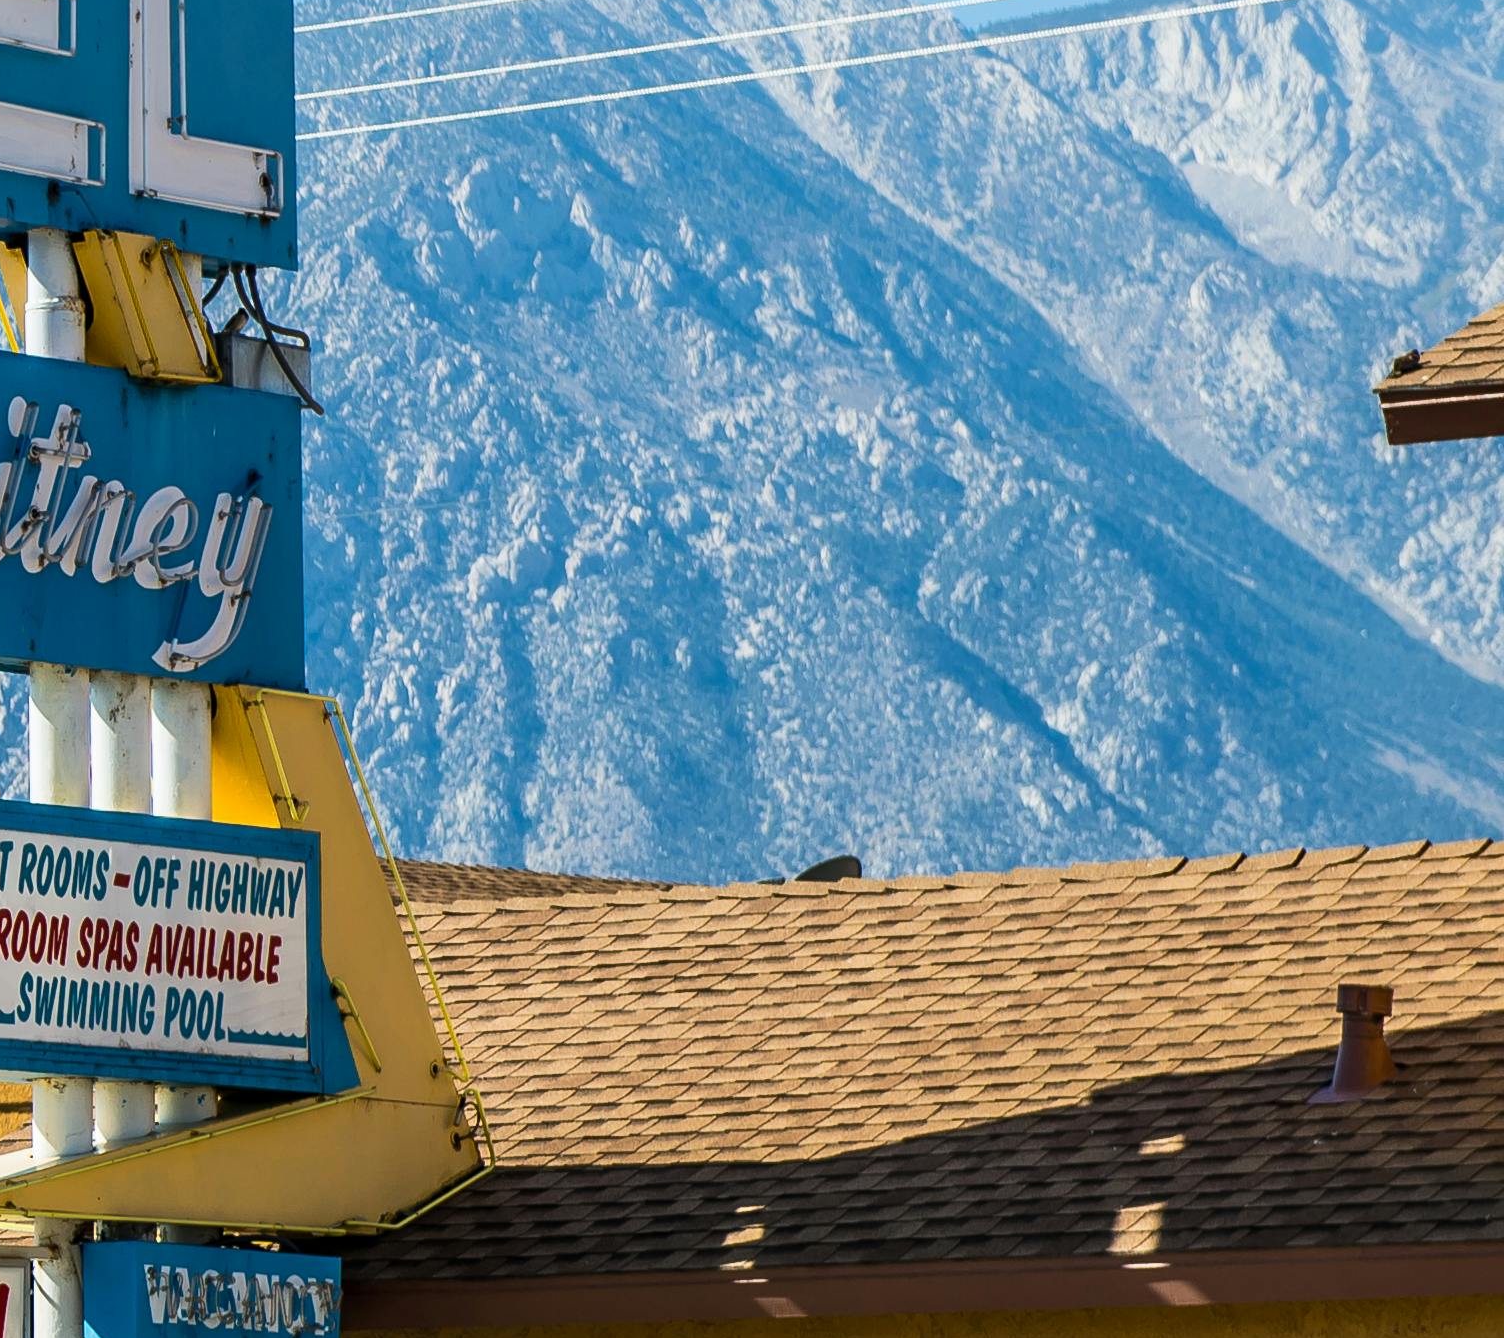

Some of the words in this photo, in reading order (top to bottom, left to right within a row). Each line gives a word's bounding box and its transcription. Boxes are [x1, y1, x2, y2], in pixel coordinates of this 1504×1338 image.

[18, 842, 111, 902] ROOMS
[133, 855, 182, 909] OFF
[188, 858, 304, 919] HIGHWAY
[76, 916, 140, 973] SPAS
[145, 922, 283, 985] AVAILABLE
[16, 970, 156, 1035] SWIMMING
[163, 986, 227, 1043] POOL
[143, 1263, 336, 1337] VACANCY
